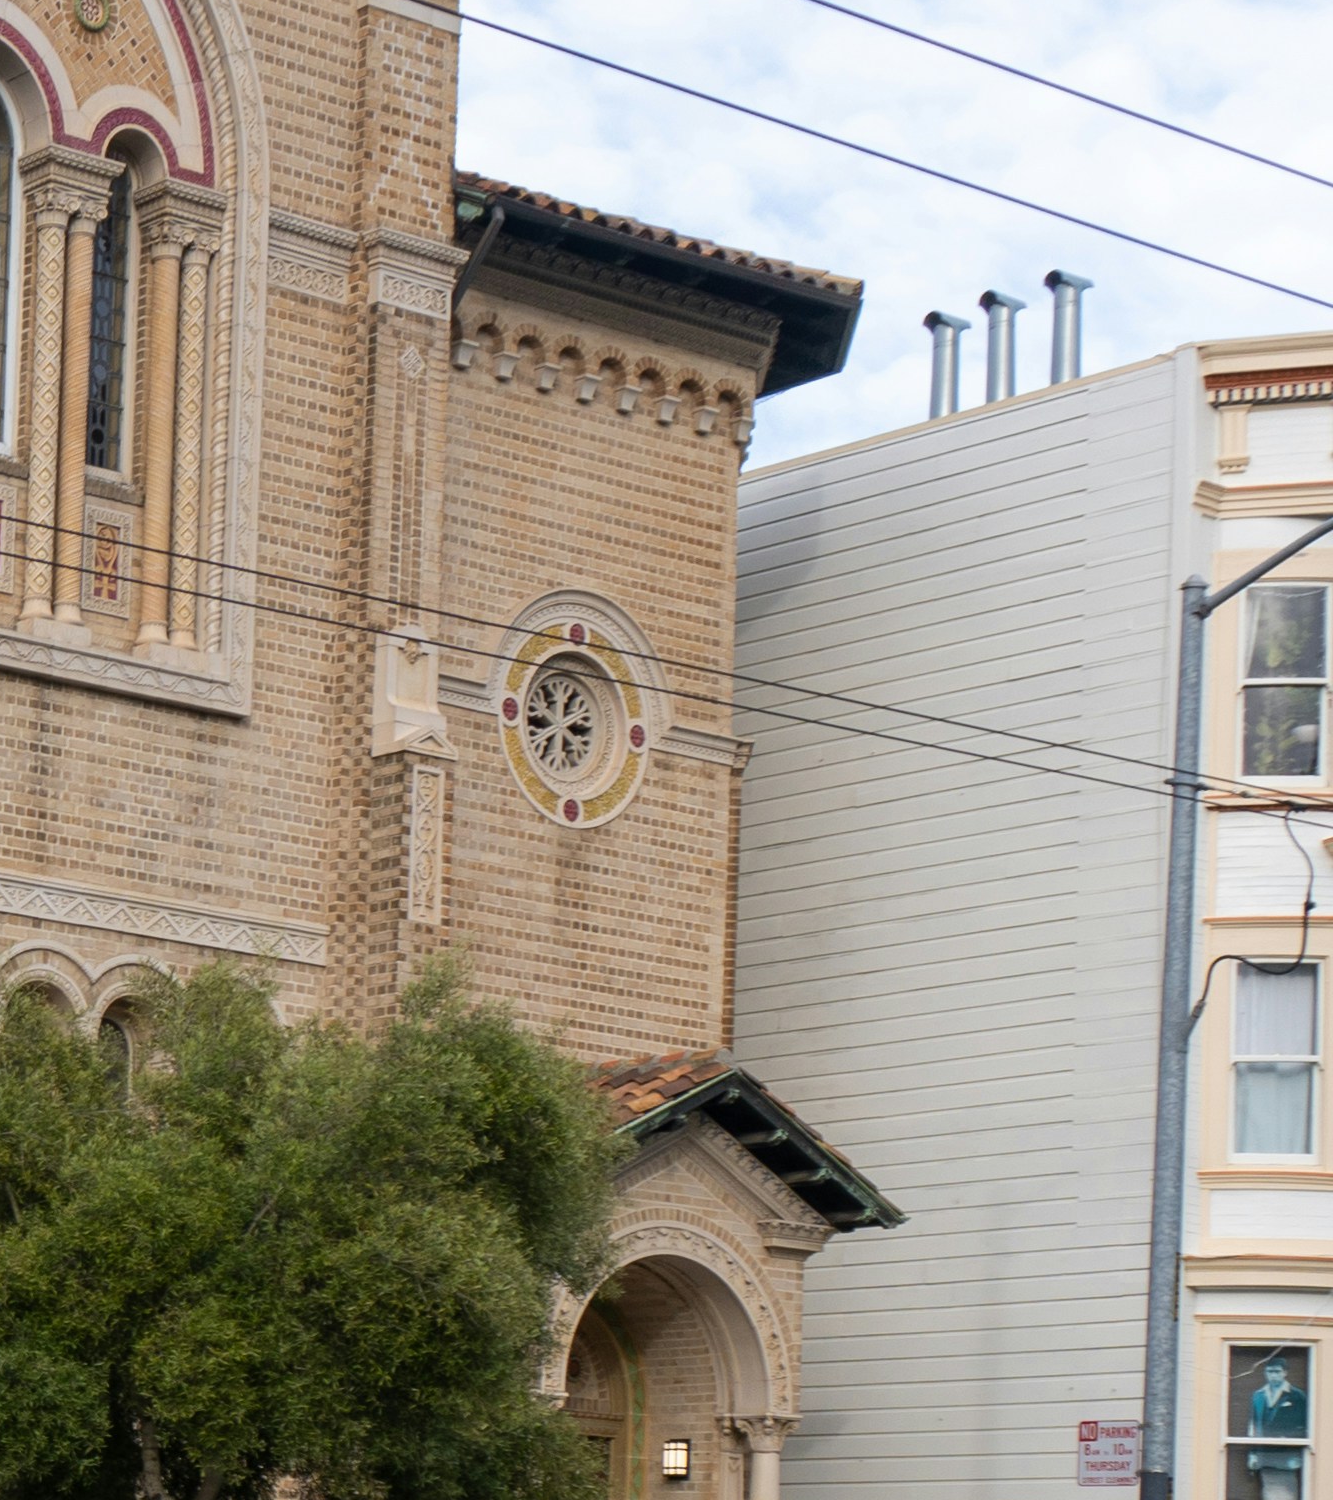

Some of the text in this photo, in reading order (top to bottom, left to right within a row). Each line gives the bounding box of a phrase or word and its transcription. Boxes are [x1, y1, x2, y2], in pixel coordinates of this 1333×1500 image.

[1081, 1423, 1137, 1440] NO PARKING
[1085, 1461, 1132, 1472] THURSDAY
